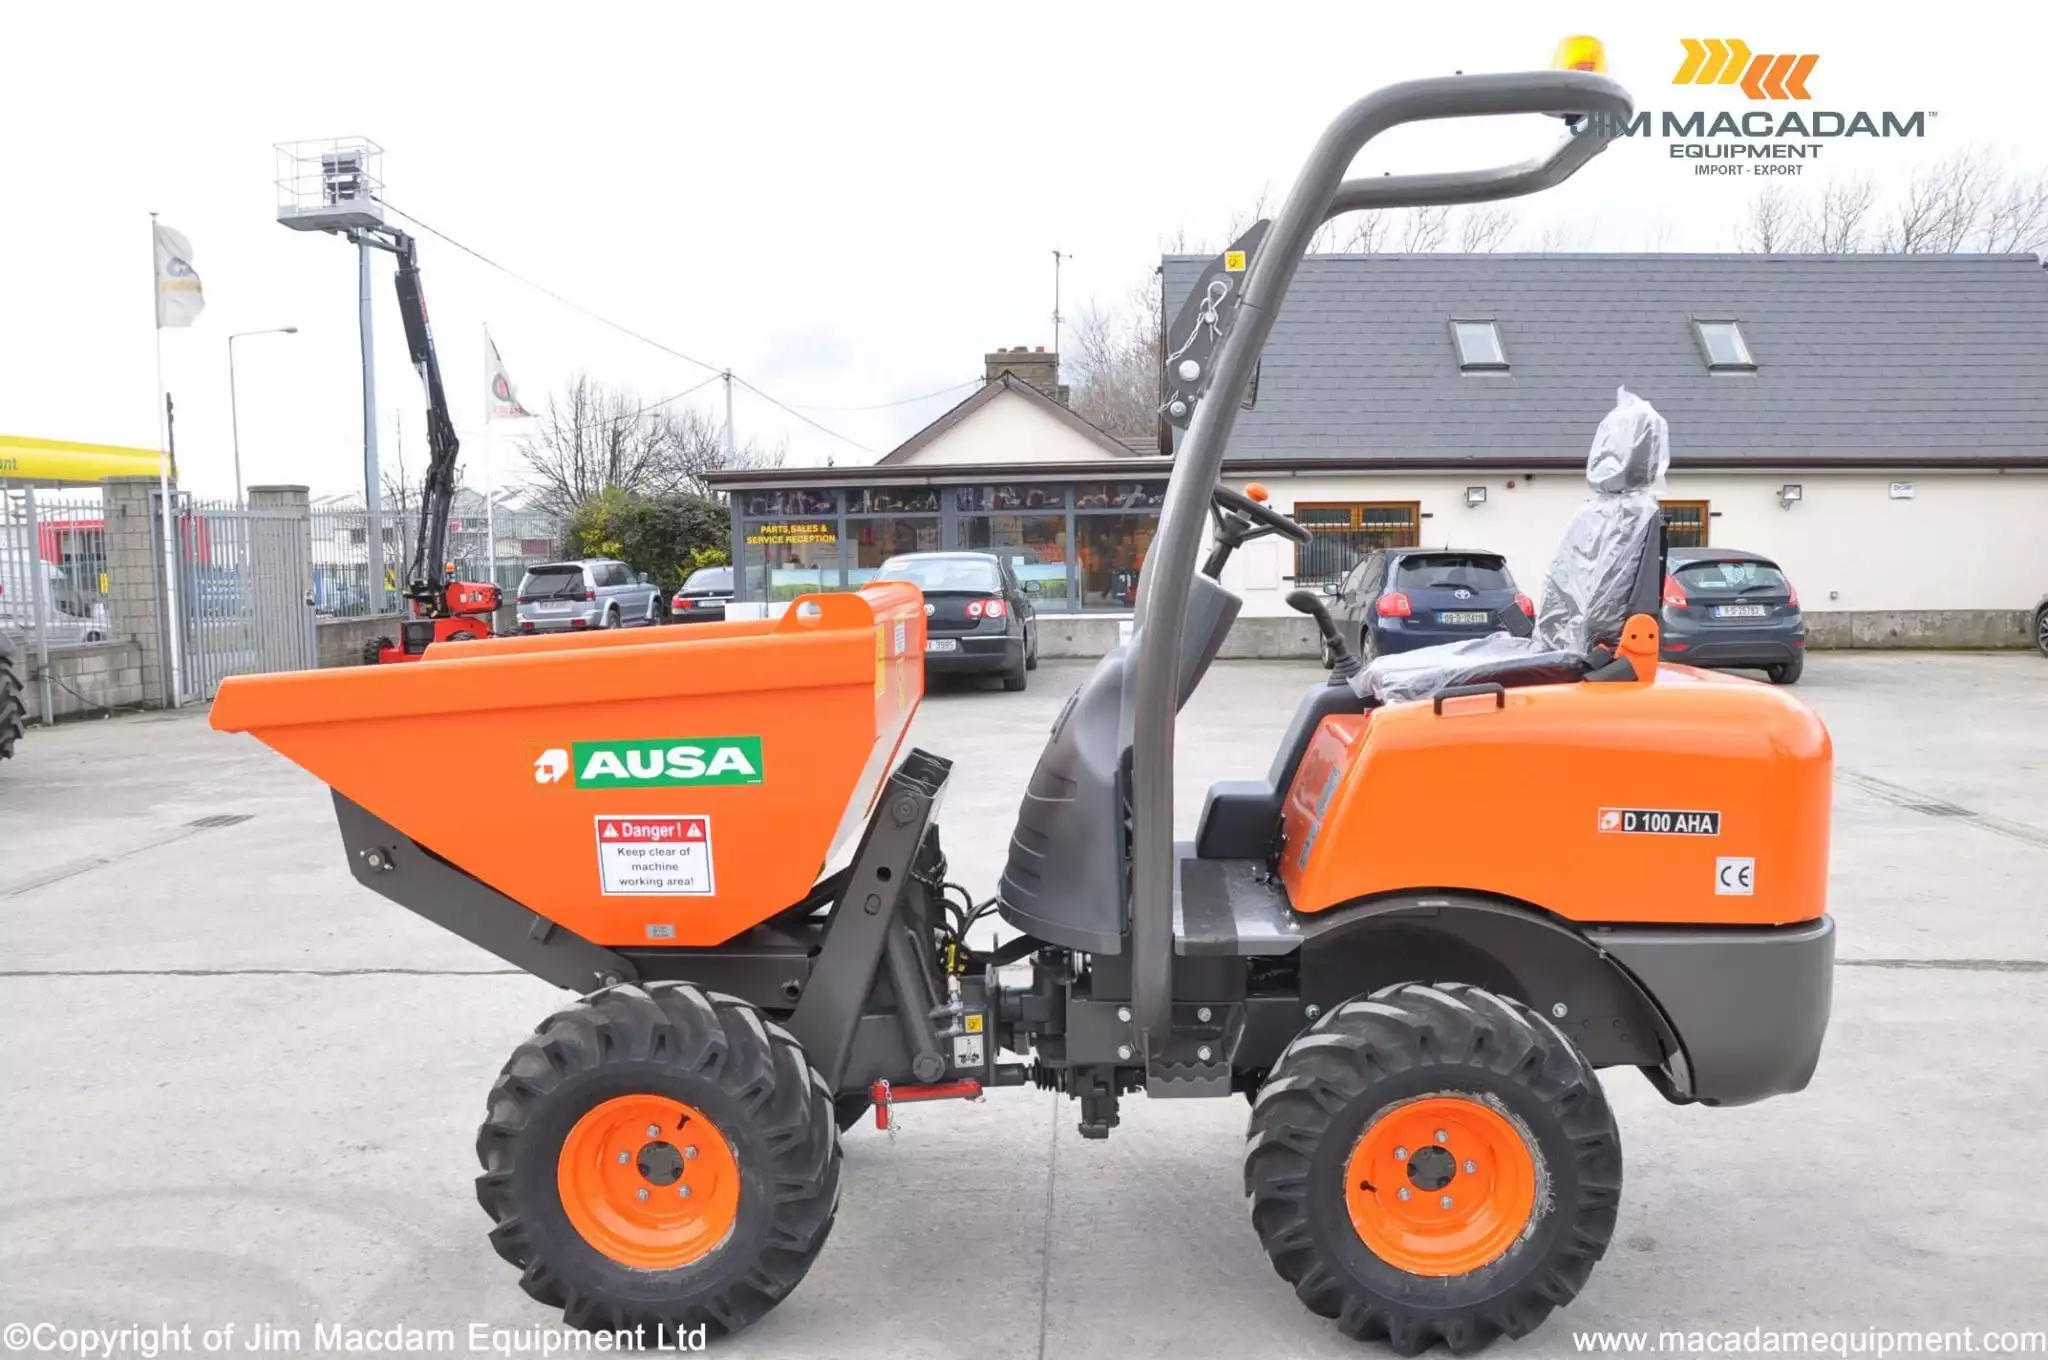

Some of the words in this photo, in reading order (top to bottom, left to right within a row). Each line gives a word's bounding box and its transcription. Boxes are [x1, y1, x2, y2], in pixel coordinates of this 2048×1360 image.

[747, 535, 784, 545] SERVICE
[786, 534, 836, 545] RECEPTION
[580, 746, 757, 780] AUSA
[1623, 812, 1637, 831] D
[1642, 814, 1671, 832] 100
[1674, 814, 1714, 833] AHA
[617, 847, 646, 858] Keep
[649, 847, 676, 856] clear
[679, 847, 691, 856] of
[632, 862, 679, 871] machine
[619, 877, 663, 887] working
[667, 876, 694, 886] area!
[1720, 865, 1750, 887] CE
